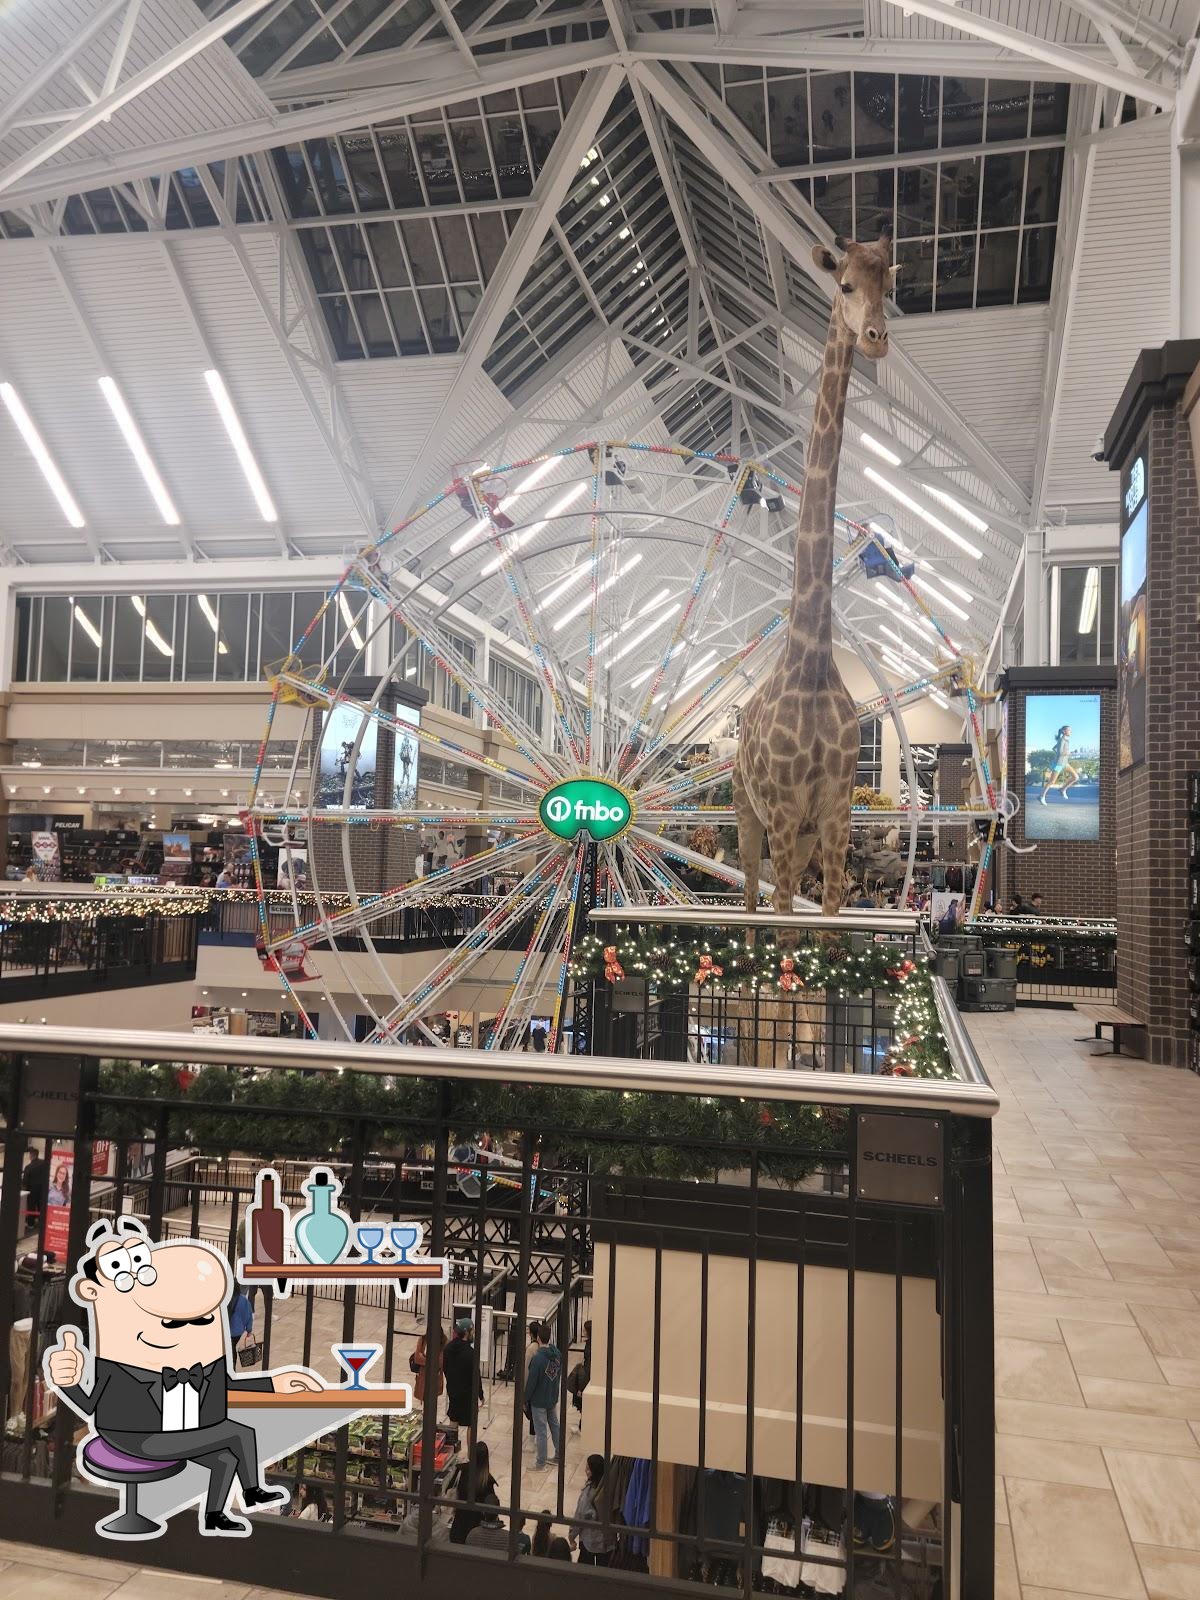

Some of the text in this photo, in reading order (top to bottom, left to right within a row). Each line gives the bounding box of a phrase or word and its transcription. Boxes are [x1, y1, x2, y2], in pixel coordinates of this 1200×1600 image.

[574, 799, 624, 822] fnbo
[55, 821, 80, 829] PELICAN
[862, 1150, 938, 1167] SCHEELS
